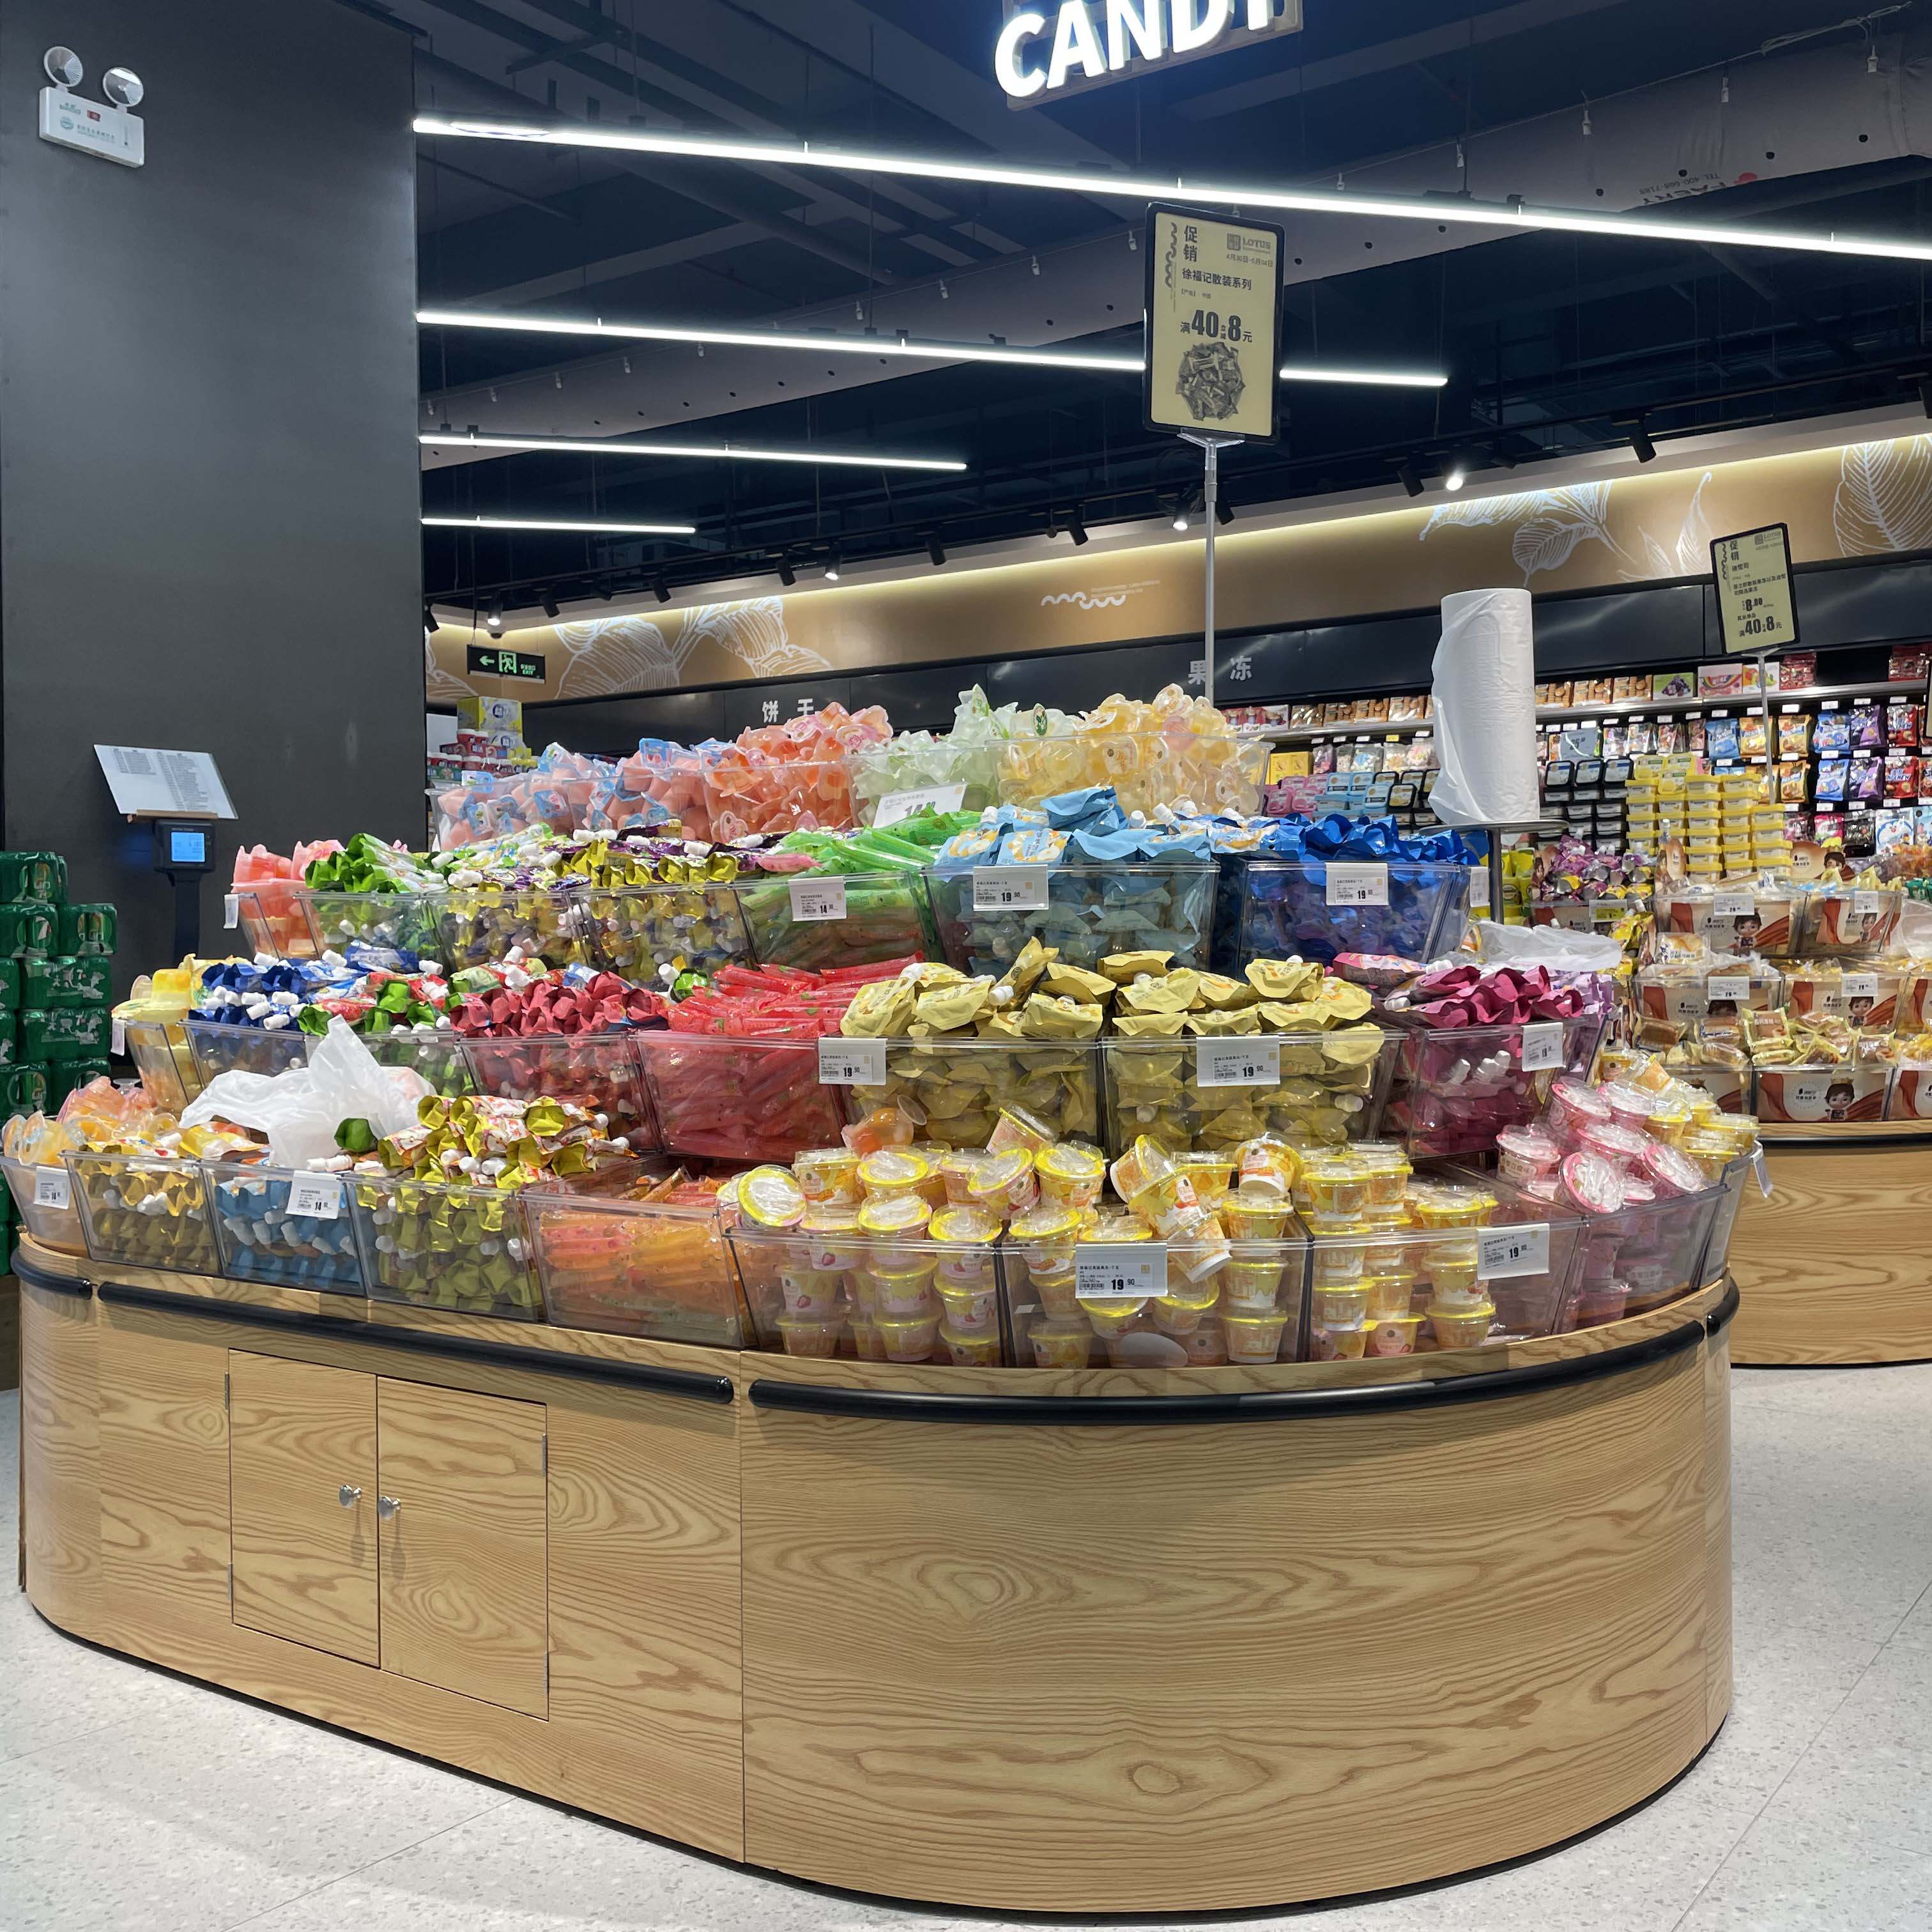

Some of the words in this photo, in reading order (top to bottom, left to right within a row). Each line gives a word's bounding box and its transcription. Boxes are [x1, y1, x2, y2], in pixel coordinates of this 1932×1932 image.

[1183, 224, 1198, 263] 促销
[1242, 237, 1271, 250] LOTUS
[1181, 268, 1252, 291] 徐福记散装系列
